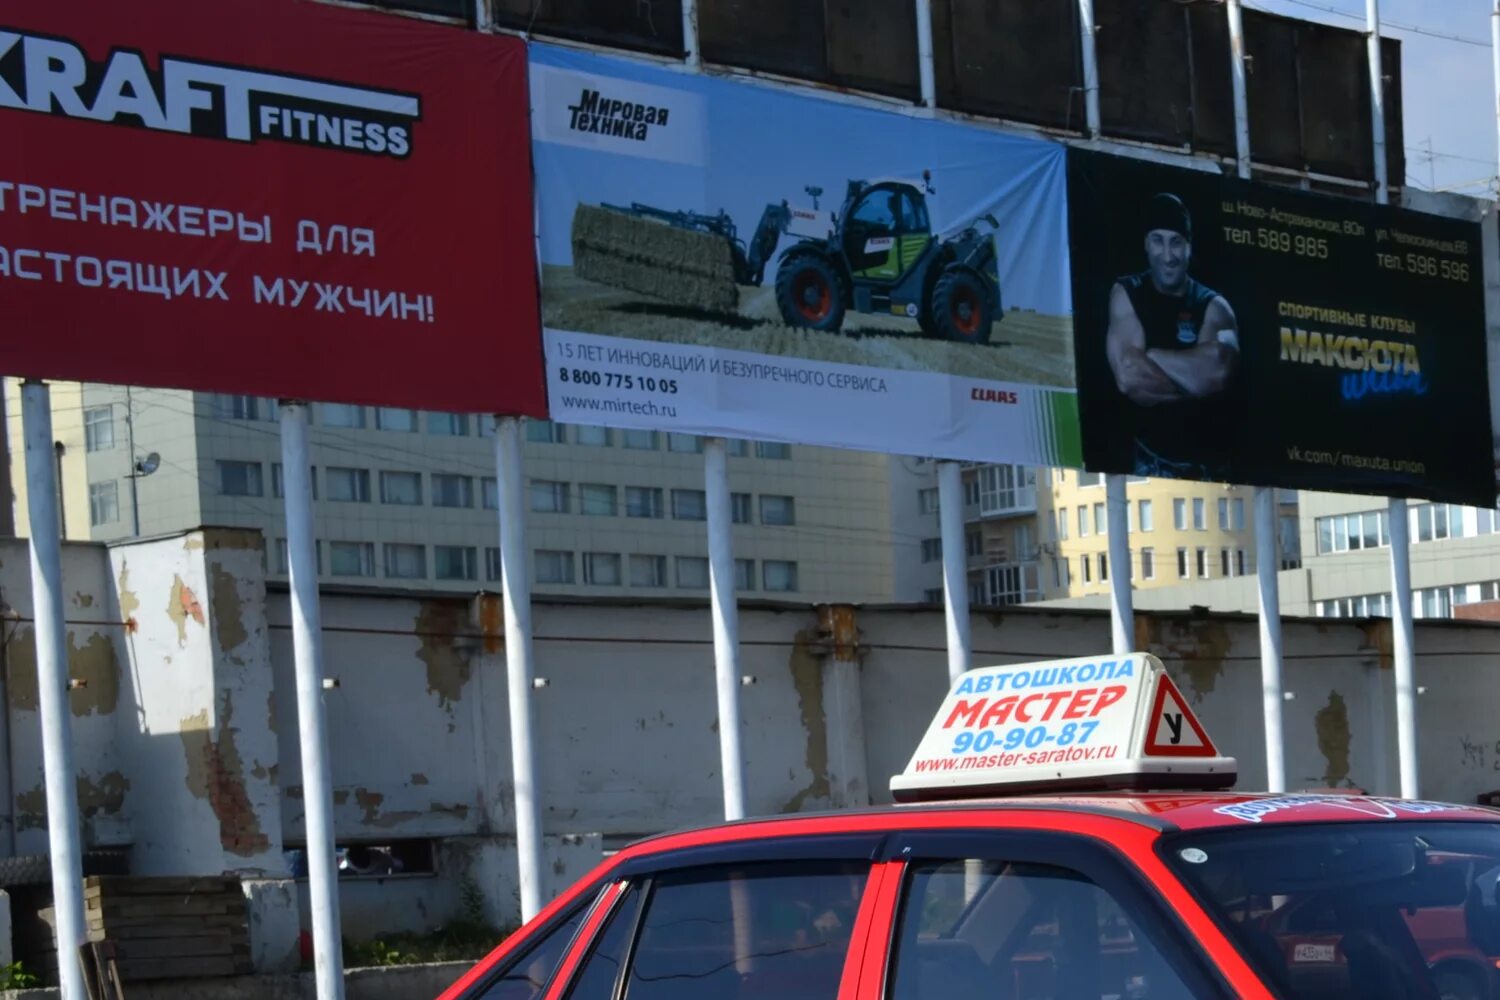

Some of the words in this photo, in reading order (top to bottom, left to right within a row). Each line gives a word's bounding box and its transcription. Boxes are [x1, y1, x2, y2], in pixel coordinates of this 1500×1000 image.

[568, 105, 648, 141] Техника
[579, 88, 669, 127] Мировая
[259, 105, 410, 156] FITNESS
[297, 221, 376, 257] ДЛЯ
[1222, 225, 1254, 246] тел.
[1257, 228, 1291, 253] 589
[1293, 235, 1329, 259] 985
[1376, 253, 1404, 270] тел.
[1406, 254, 1438, 276] 596
[1440, 259, 1470, 283] 596
[253, 275, 435, 324] МУЖЧИН!
[1278, 302, 1368, 328] СПОРТИВНЫЕ
[1371, 315, 1416, 334] КЛУБЫ
[558, 342, 573, 358] 15
[577, 344, 604, 362] ЛЕТ
[608, 347, 705, 374] ИННОВАЦИЙ
[710, 359, 721, 374] И
[722, 359, 824, 387] БЕЗУПРЕЧНОГО
[828, 372, 888, 393] СЕРВИСА
[1280, 327, 1421, 375] МАКСЮТА
[559, 368, 569, 382] 8
[572, 371, 601, 387] 800
[604, 373, 633, 389] 775
[637, 376, 656, 392] 10
[659, 378, 678, 394] 05
[970, 387, 1018, 404] CLAAS
[561, 395, 678, 418] www.mirtech.ru
[954, 659, 1135, 696] АВТОШКОЛА
[942, 685, 1128, 730] МАСТЕР
[951, 721, 1100, 754] 90-90-87
[914, 744, 1118, 773] www.master-saratov.ru
